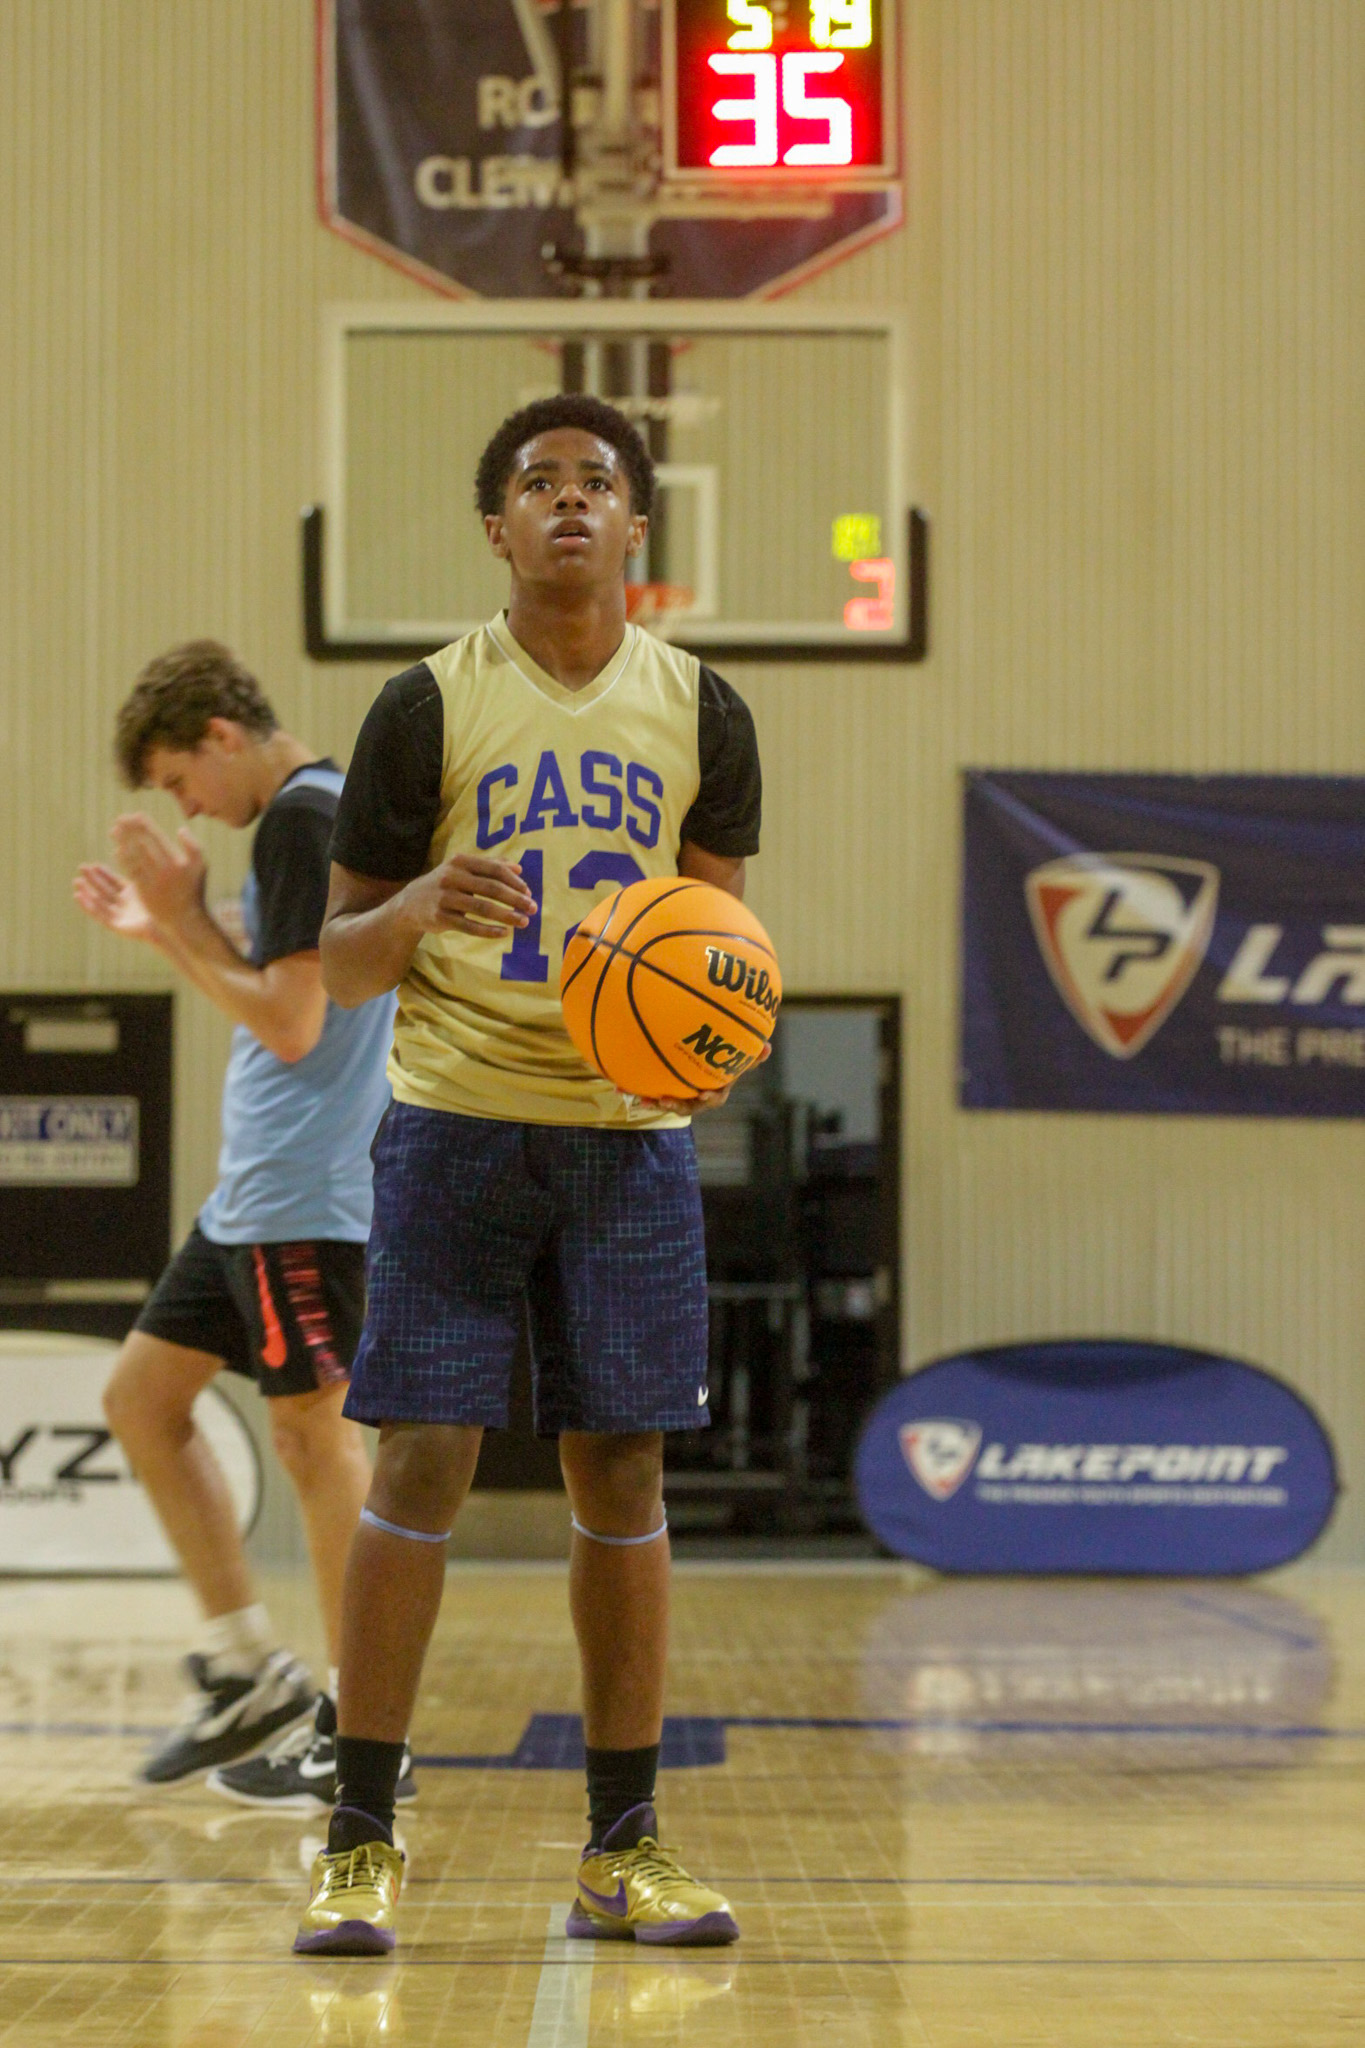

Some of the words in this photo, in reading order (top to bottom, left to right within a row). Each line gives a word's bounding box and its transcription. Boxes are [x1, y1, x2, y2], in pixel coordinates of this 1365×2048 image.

[707, 52, 853, 166] 35
[475, 750, 664, 850] CASS
[976, 1443, 1288, 1483] LAKEPOINT
